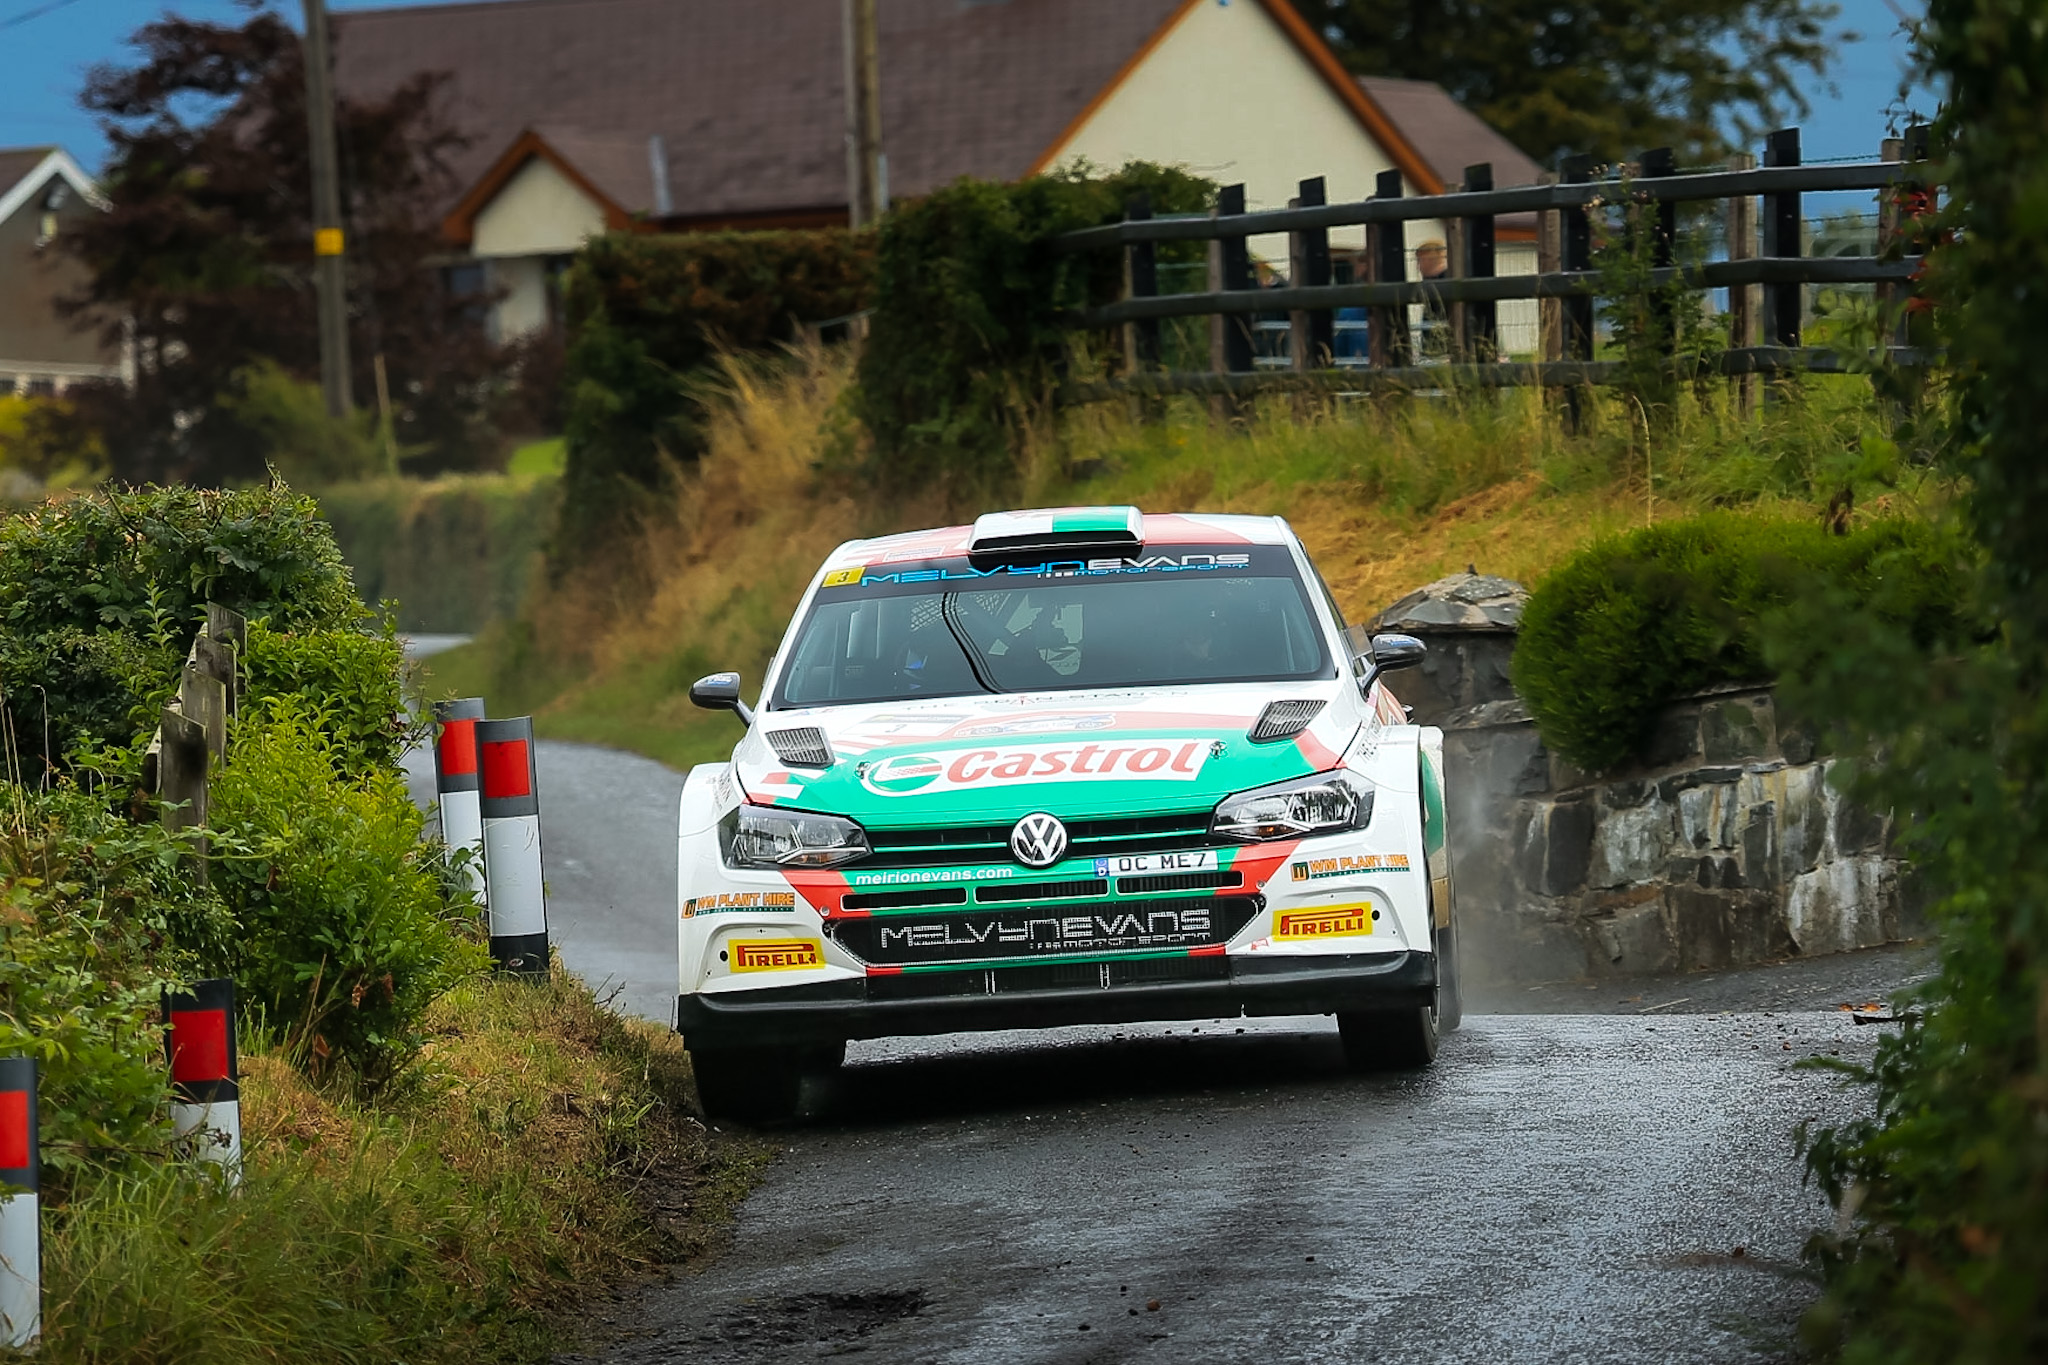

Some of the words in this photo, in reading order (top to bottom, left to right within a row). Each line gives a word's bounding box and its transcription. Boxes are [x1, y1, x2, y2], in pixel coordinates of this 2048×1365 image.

[839, 571, 850, 583] 3
[946, 742, 1201, 784] Castrol
[1339, 855, 1383, 870] PLANT
[855, 867, 1013, 886] meirionevans.com
[717, 892, 761, 907] PLANT
[762, 892, 796, 906] HIRE
[1280, 908, 1365, 936] PIRELLI
[736, 942, 817, 967] PIRELLI
